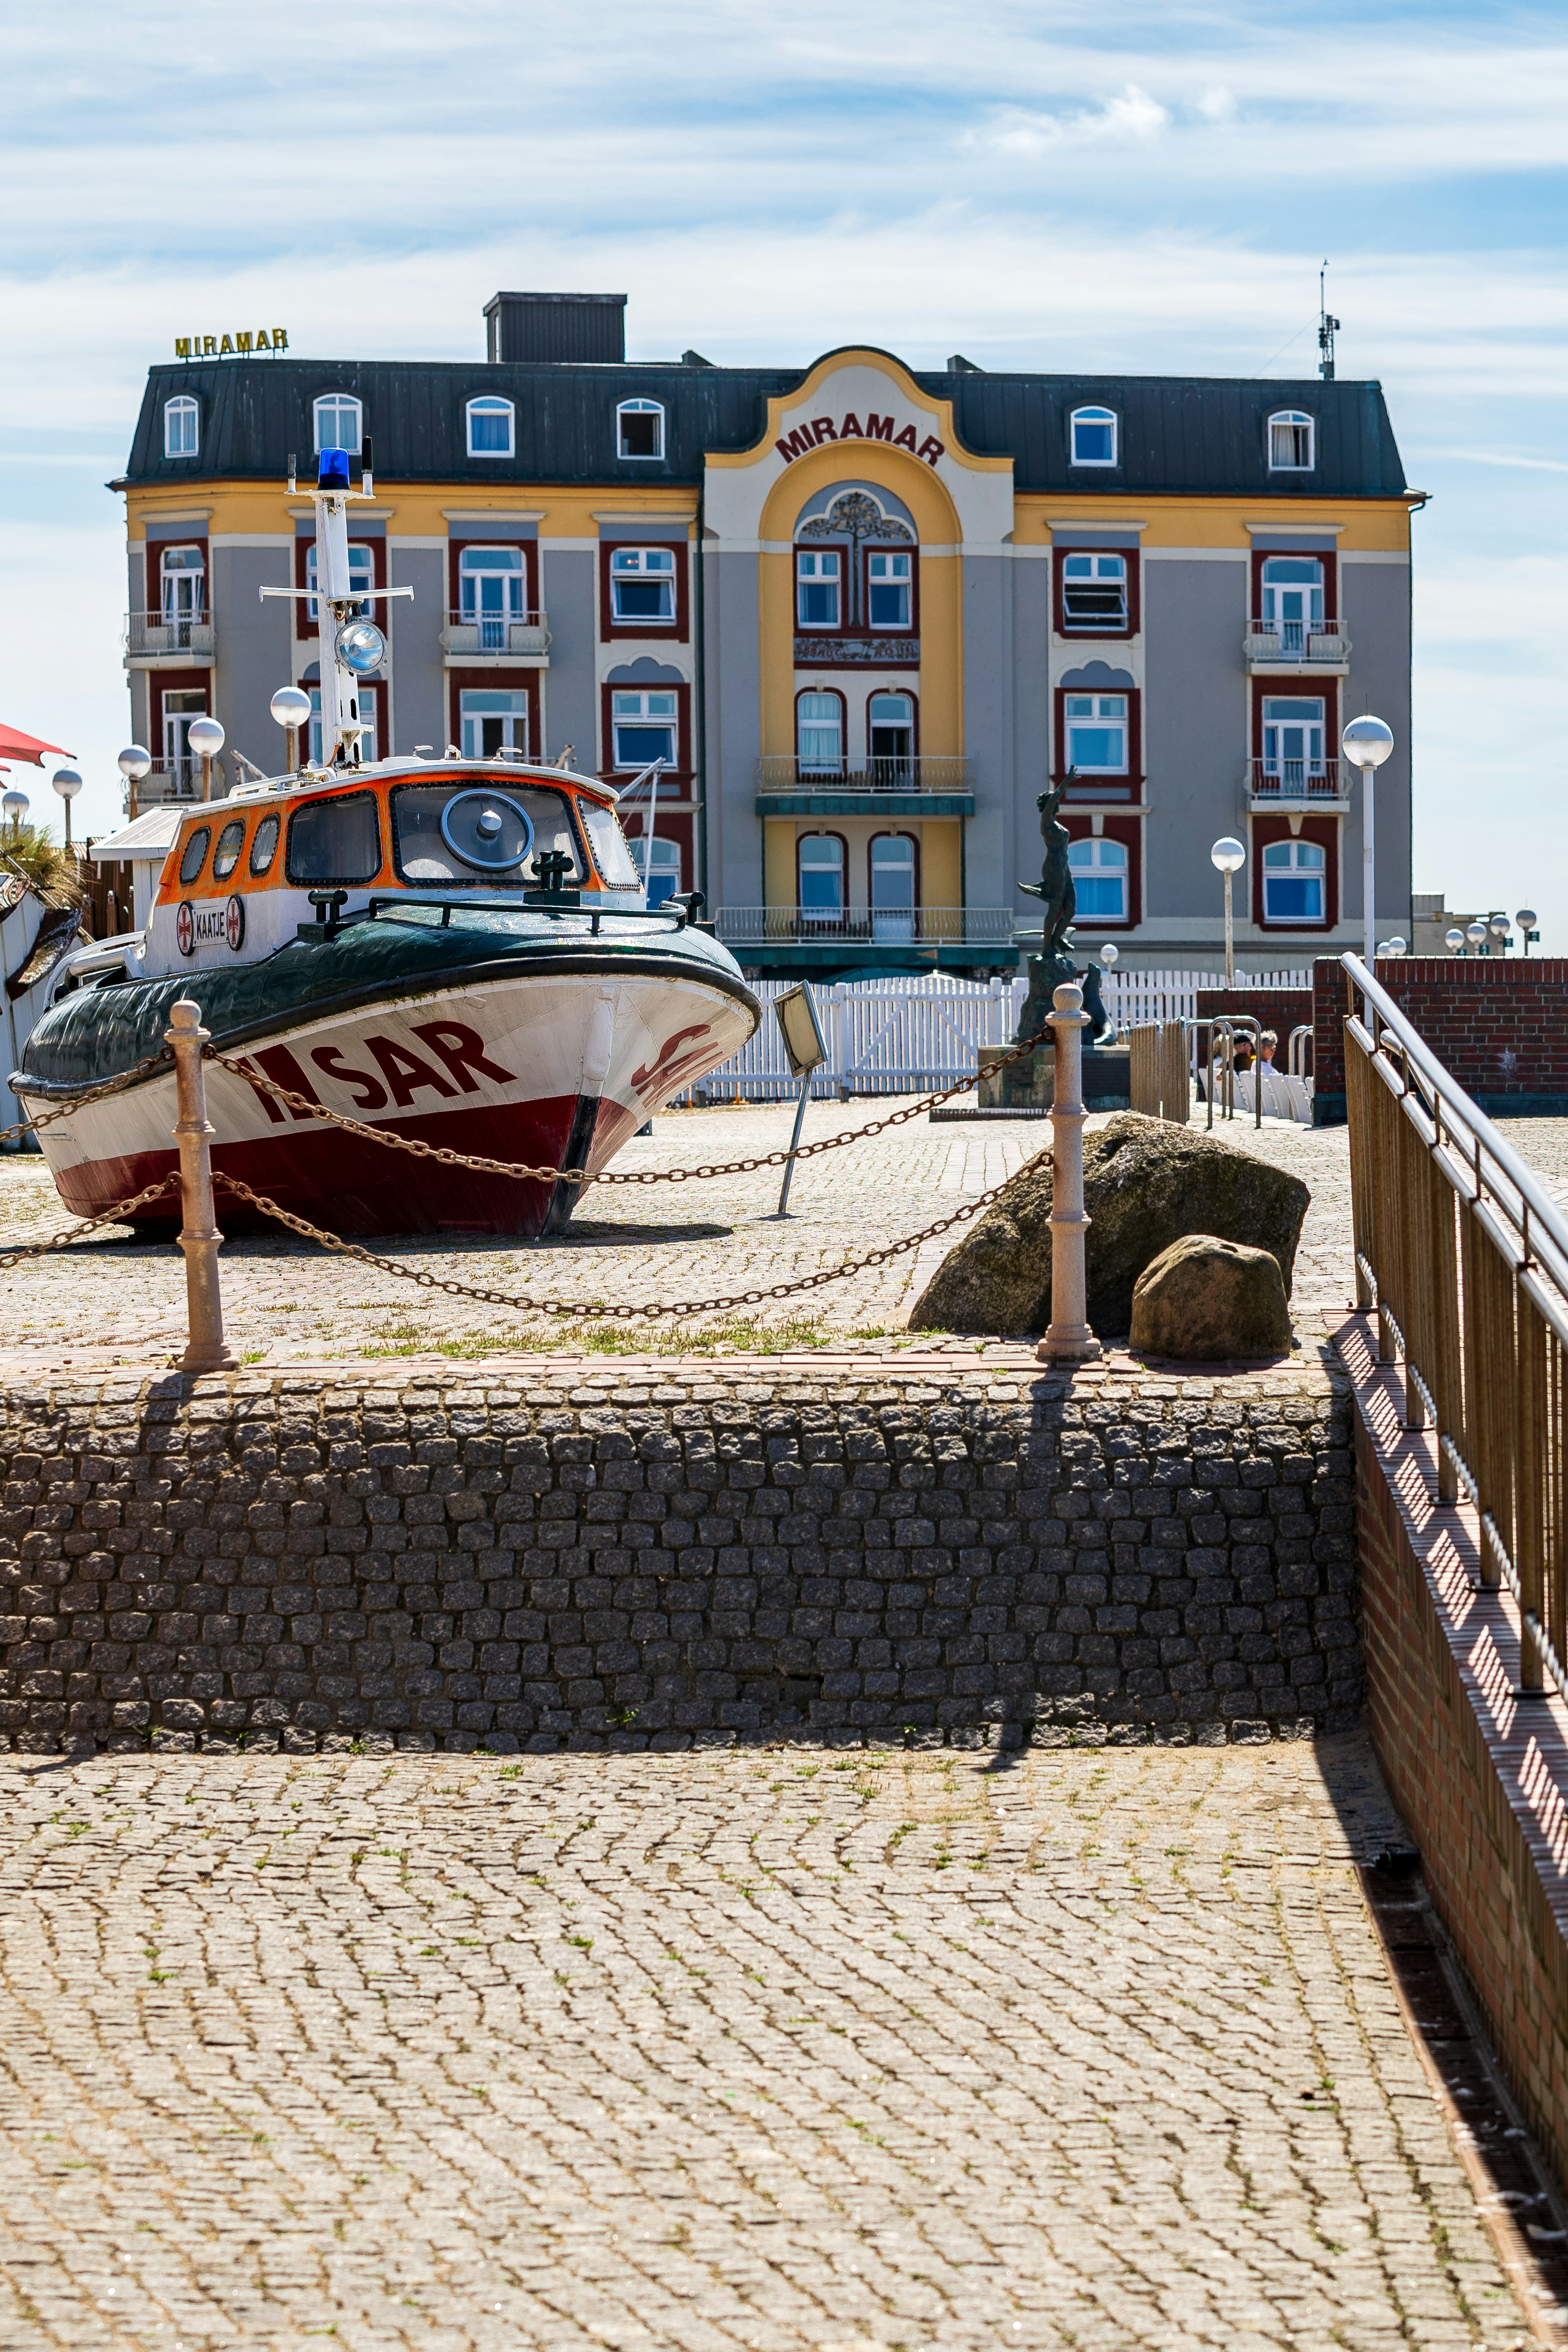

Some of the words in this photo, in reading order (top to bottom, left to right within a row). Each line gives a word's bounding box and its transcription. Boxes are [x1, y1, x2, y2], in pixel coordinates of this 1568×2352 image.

[175, 328, 289, 357] MIRAMAR
[775, 412, 945, 467] MIRAMAR
[196, 911, 226, 939] KAATJE
